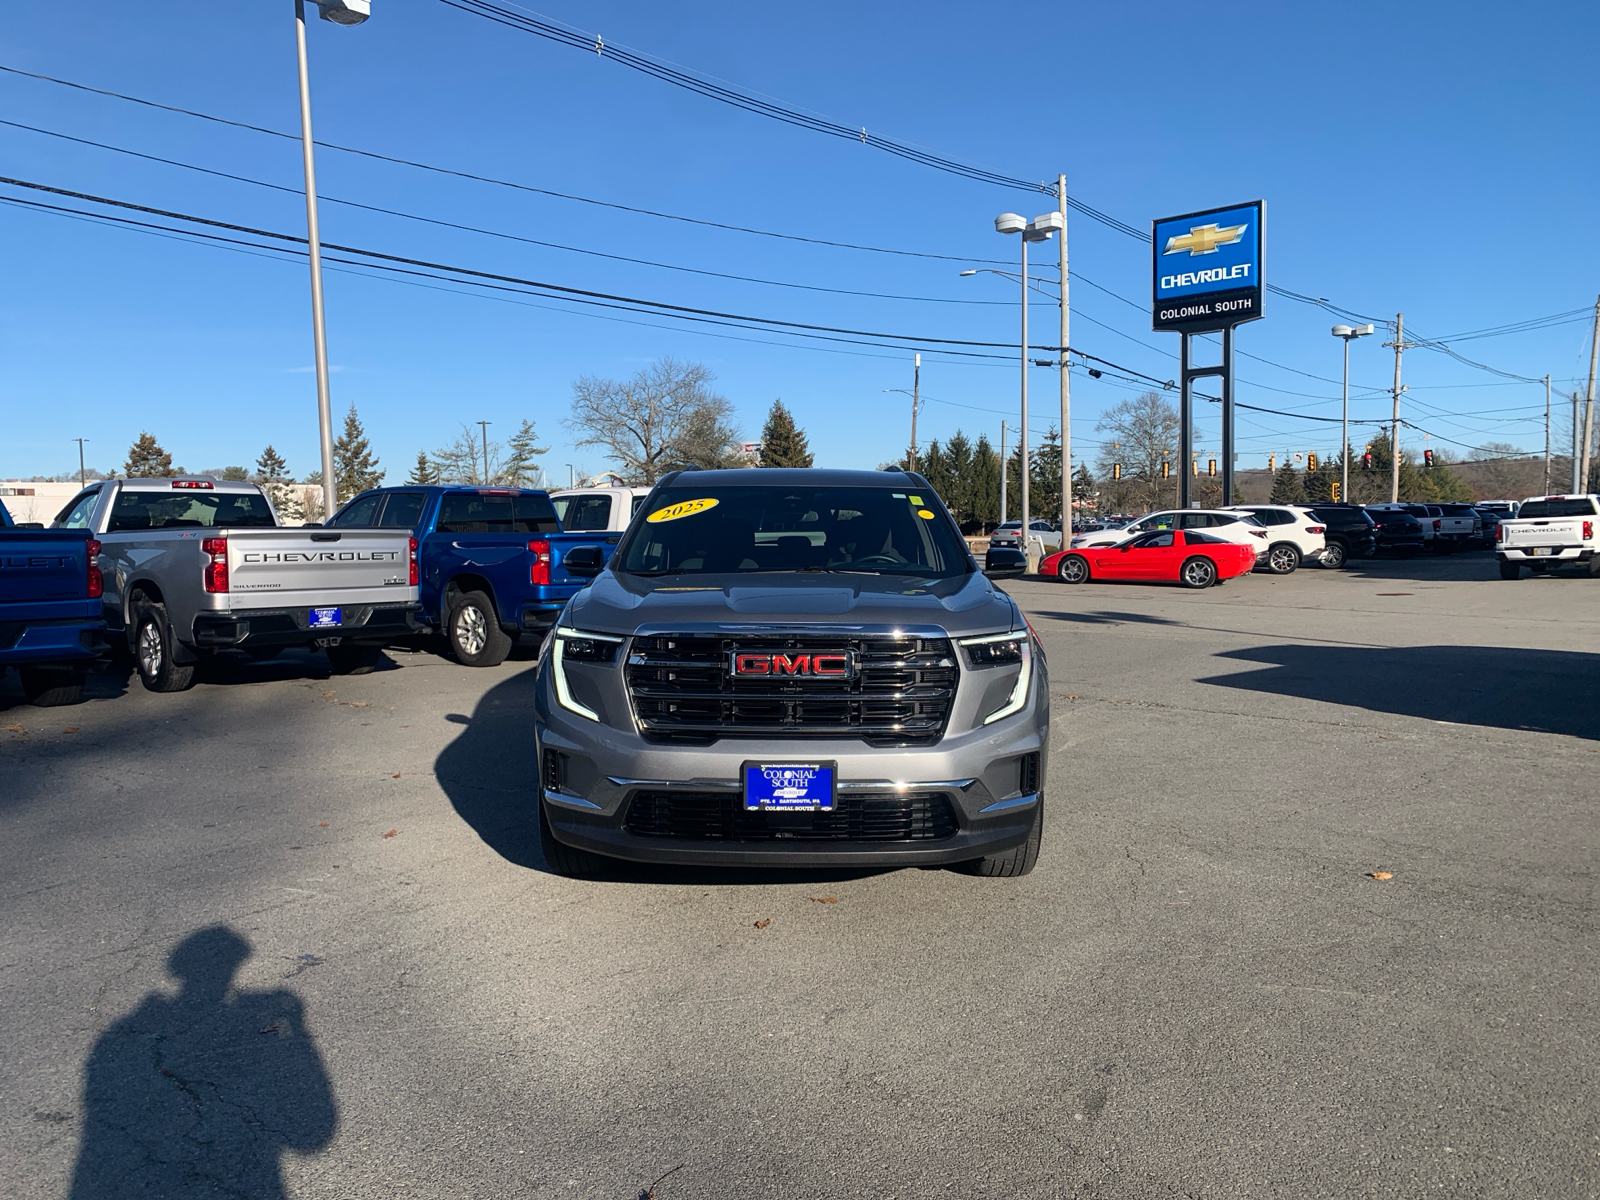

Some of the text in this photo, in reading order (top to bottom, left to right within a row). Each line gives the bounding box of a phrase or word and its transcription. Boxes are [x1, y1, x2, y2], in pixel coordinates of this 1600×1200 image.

[1160, 263, 1252, 289] CHEVROLET
[1160, 298, 1252, 320] COLONIAL SOUTH
[660, 500, 705, 520] 2025
[243, 551, 400, 563] CHEVROLET
[736, 654, 847, 675] GMC
[763, 770, 816, 779] COLONIAL
[771, 778, 808, 788] SOUTH
